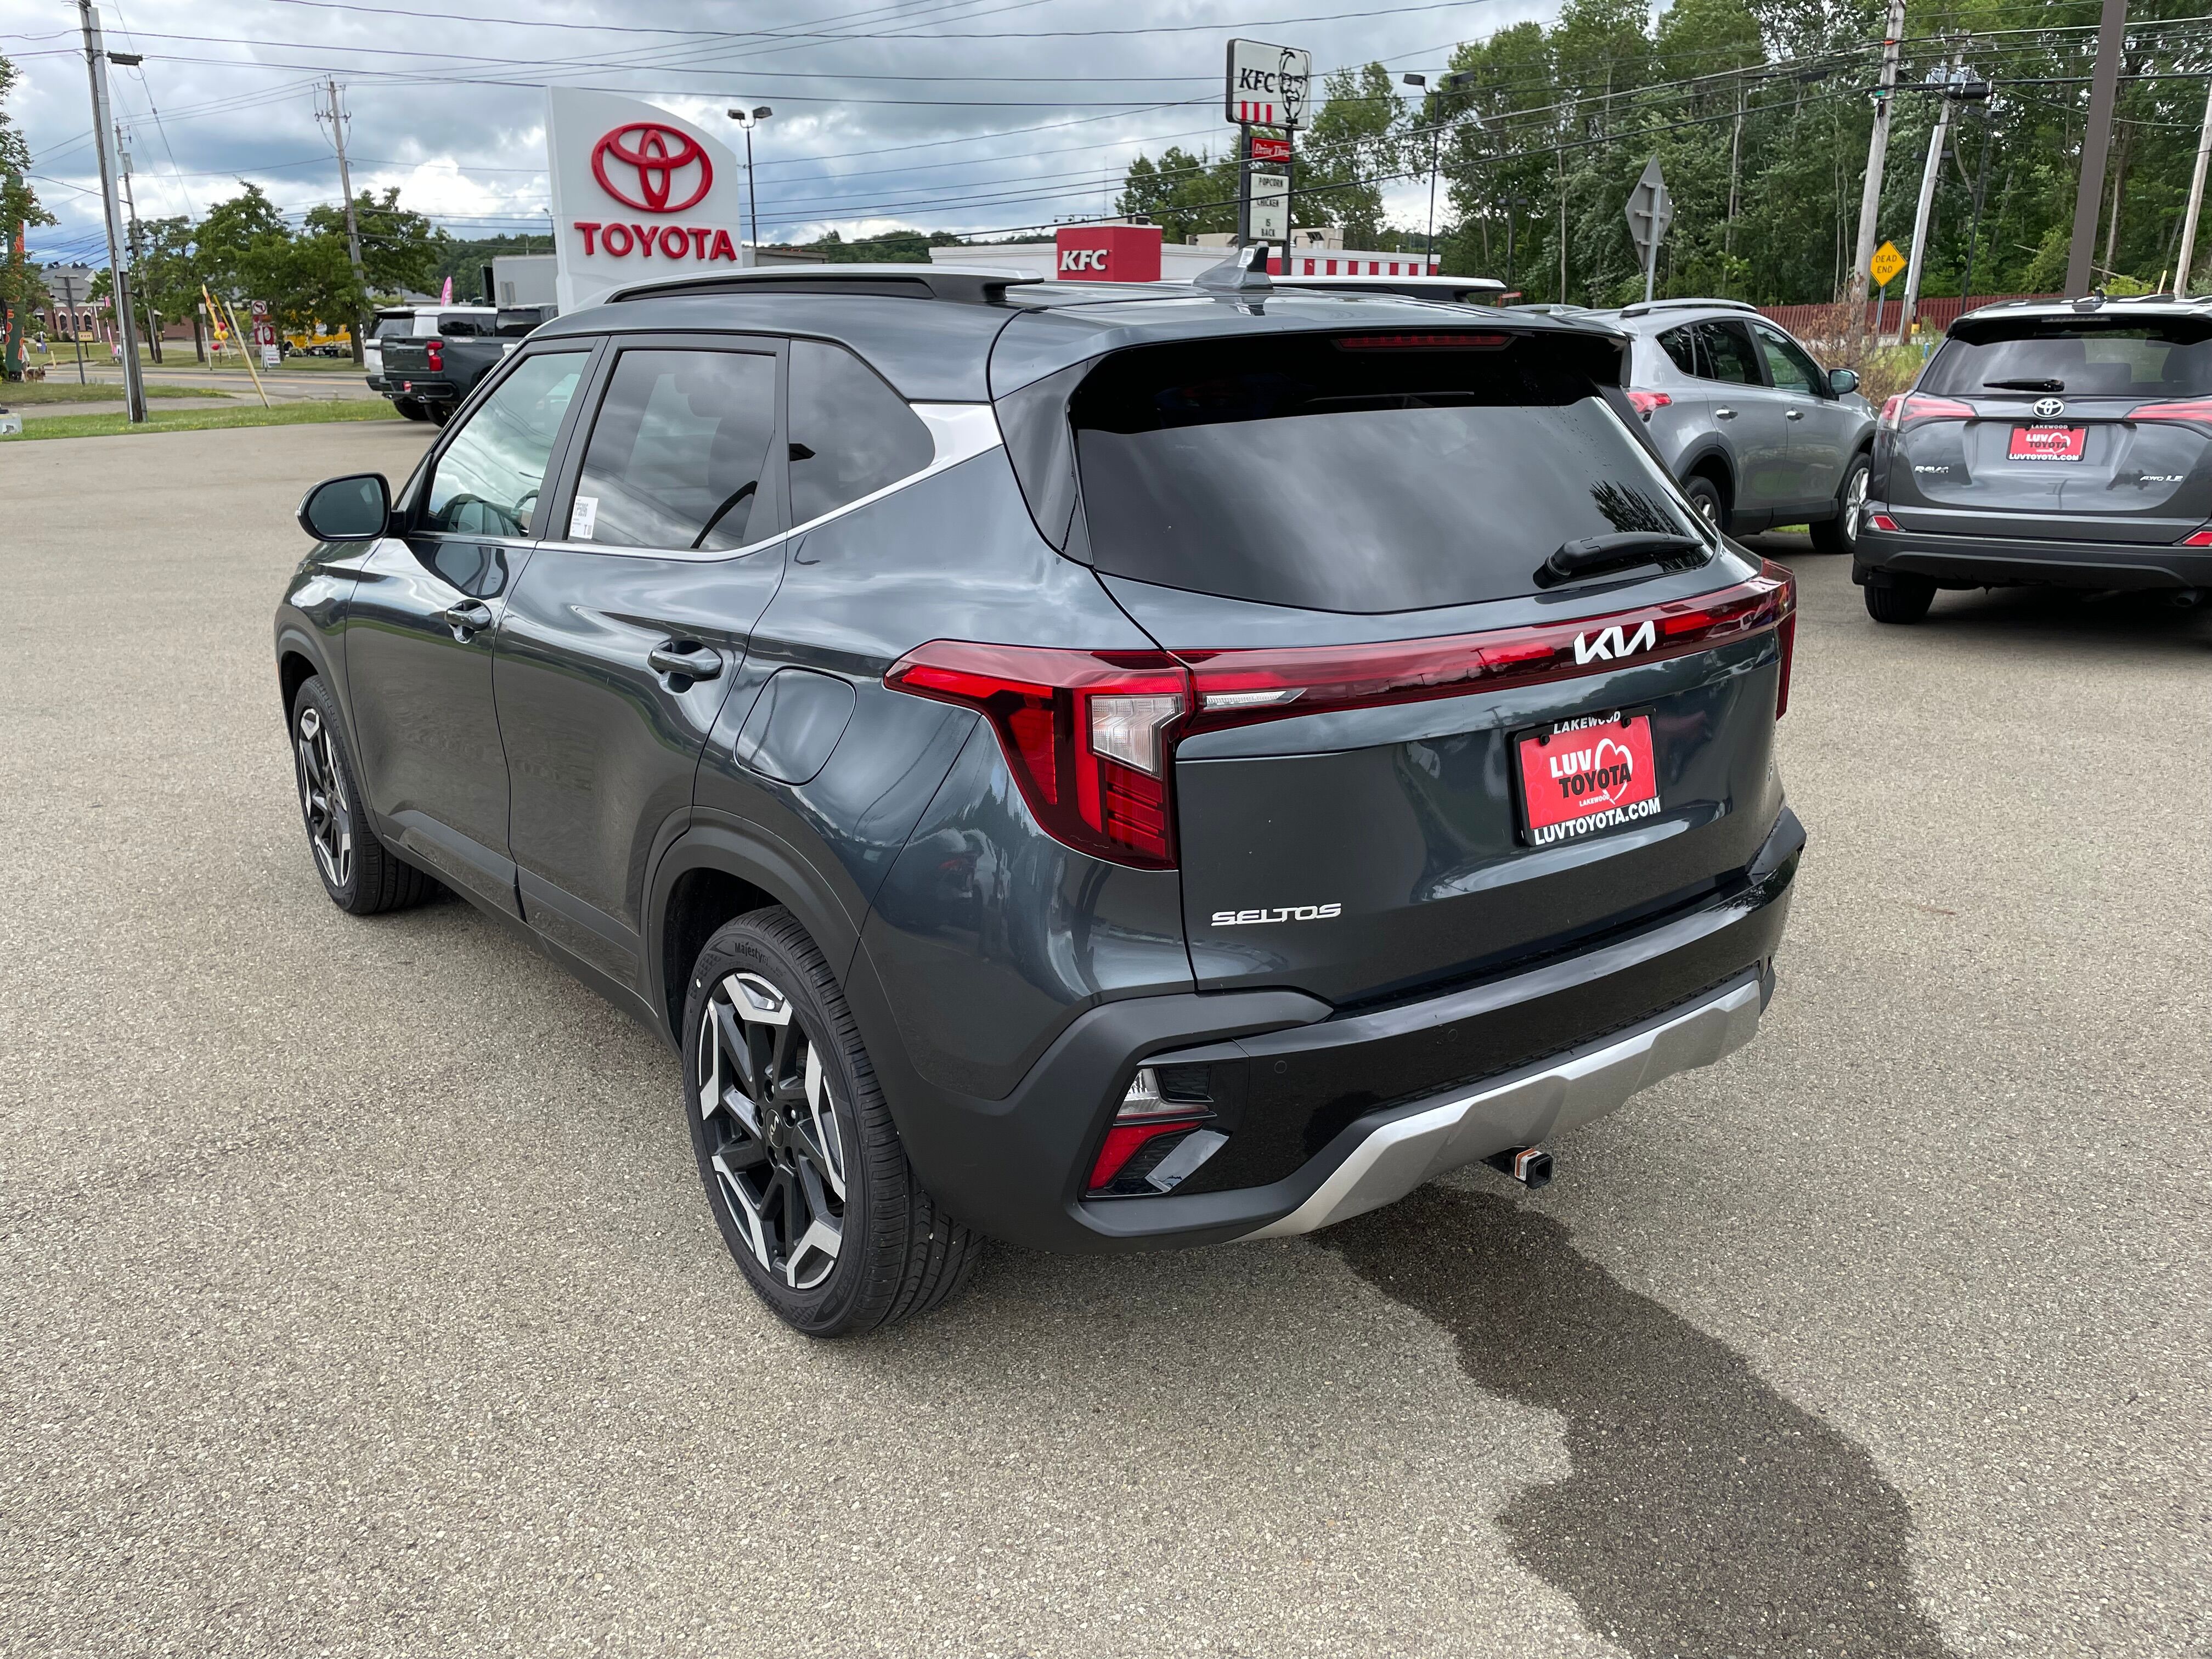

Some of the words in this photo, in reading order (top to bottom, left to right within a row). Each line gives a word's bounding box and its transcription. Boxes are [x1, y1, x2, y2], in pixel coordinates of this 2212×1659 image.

[1239, 67, 1276, 93] KFC
[1261, 228, 1275, 236] BACK
[1266, 218, 1271, 227] IS
[574, 221, 737, 261] TOYOTA
[1059, 249, 1108, 271] KFC
[2025, 433, 2049, 442] LUV
[1573, 620, 1656, 665] KIA
[1550, 749, 1592, 778] LUV
[1559, 763, 1632, 799] TOYOTA
[1579, 793, 1610, 807] LAKEWOOD
[1534, 796, 1661, 845] LUVTOYOTA.COM
[1211, 903, 1341, 926] SELTOS
